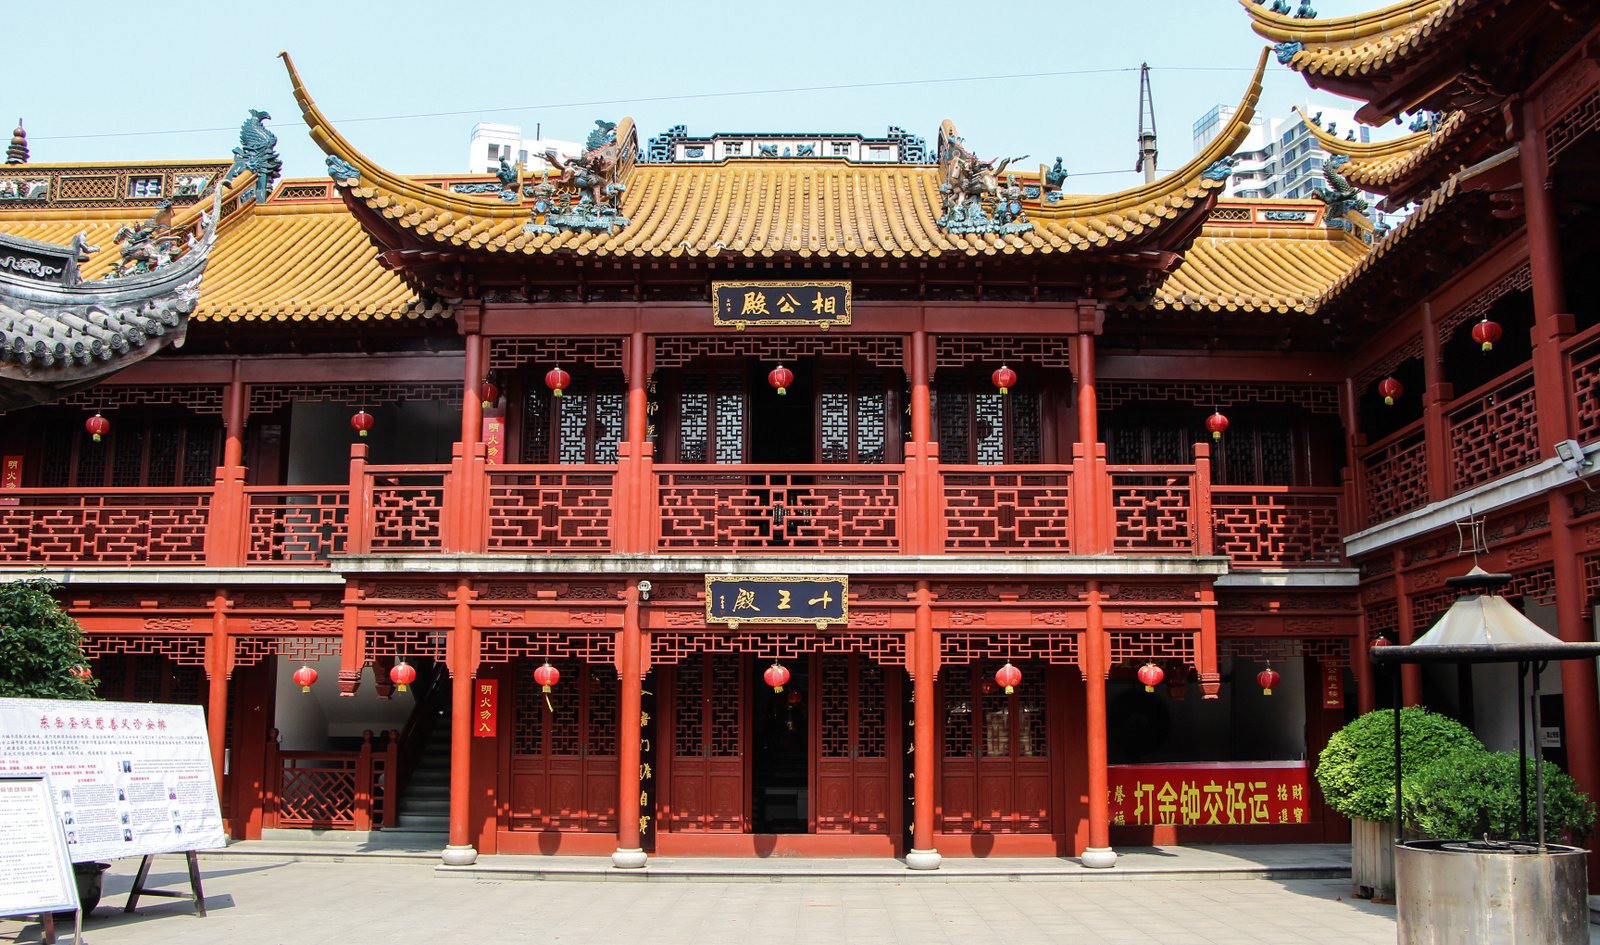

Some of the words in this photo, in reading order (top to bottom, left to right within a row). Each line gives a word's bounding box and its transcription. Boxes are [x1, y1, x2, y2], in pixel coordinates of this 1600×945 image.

[740, 291, 836, 316] 相公殿
[732, 587, 833, 613] 十王殿
[480, 684, 493, 732] 明火勿入
[39, 715, 167, 731] 东岳圣诞慈善义诊安排
[1134, 780, 1270, 826] 打金钟交好运
